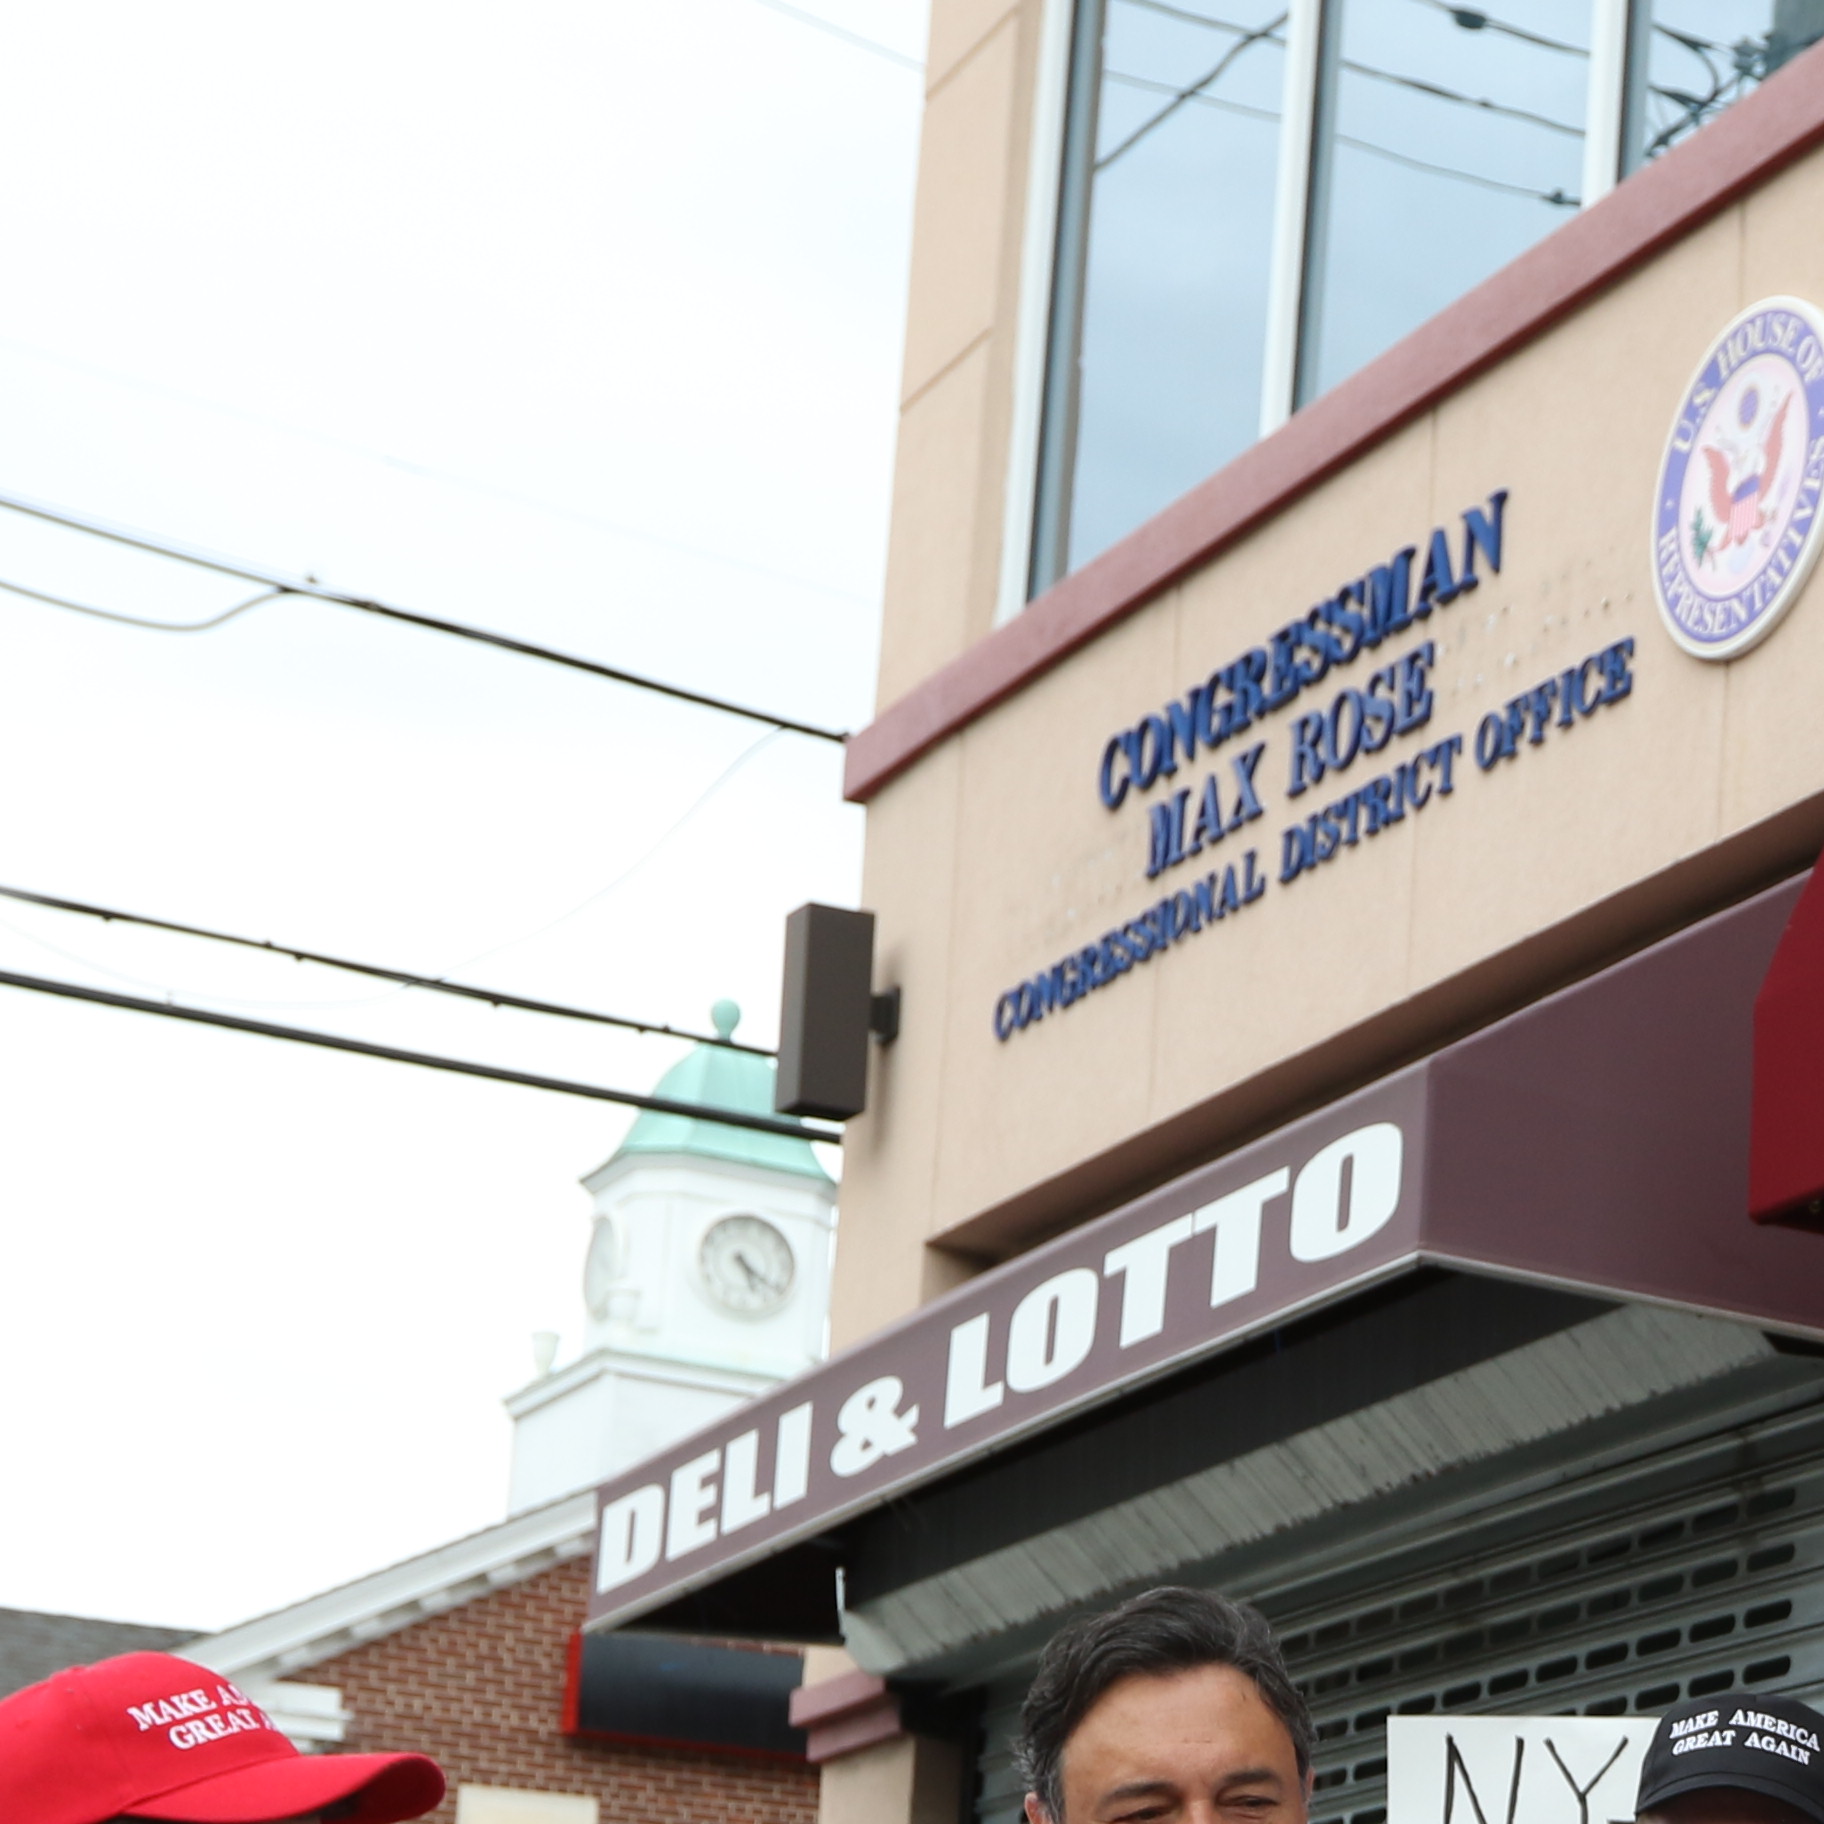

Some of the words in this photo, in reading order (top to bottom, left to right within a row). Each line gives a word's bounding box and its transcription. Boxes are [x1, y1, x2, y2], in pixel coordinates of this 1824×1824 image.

[1673, 383, 1717, 453] U.S.
[1716, 311, 1801, 379] HOUSE
[1098, 488, 1509, 812] CONGRESSMAN
[1144, 742, 1267, 879] MAX
[1287, 640, 1436, 798] ROSE
[992, 850, 1265, 1040] CONGRESSIONAL
[1279, 734, 1462, 884] DISTRICT
[1474, 636, 1636, 771] OFFICE
[596, 1402, 813, 1596] DELI
[830, 1375, 920, 1478] &
[943, 1122, 1403, 1430] LOTTO
[127, 1689, 217, 1731] MAKE
[169, 1708, 260, 1750] GREAT
[1669, 1710, 1719, 1739] MAKE
[1729, 1709, 1821, 1751] AMERICA
[1672, 1730, 1736, 1755] GREAT
[1744, 1732, 1810, 1765] AGAIN
